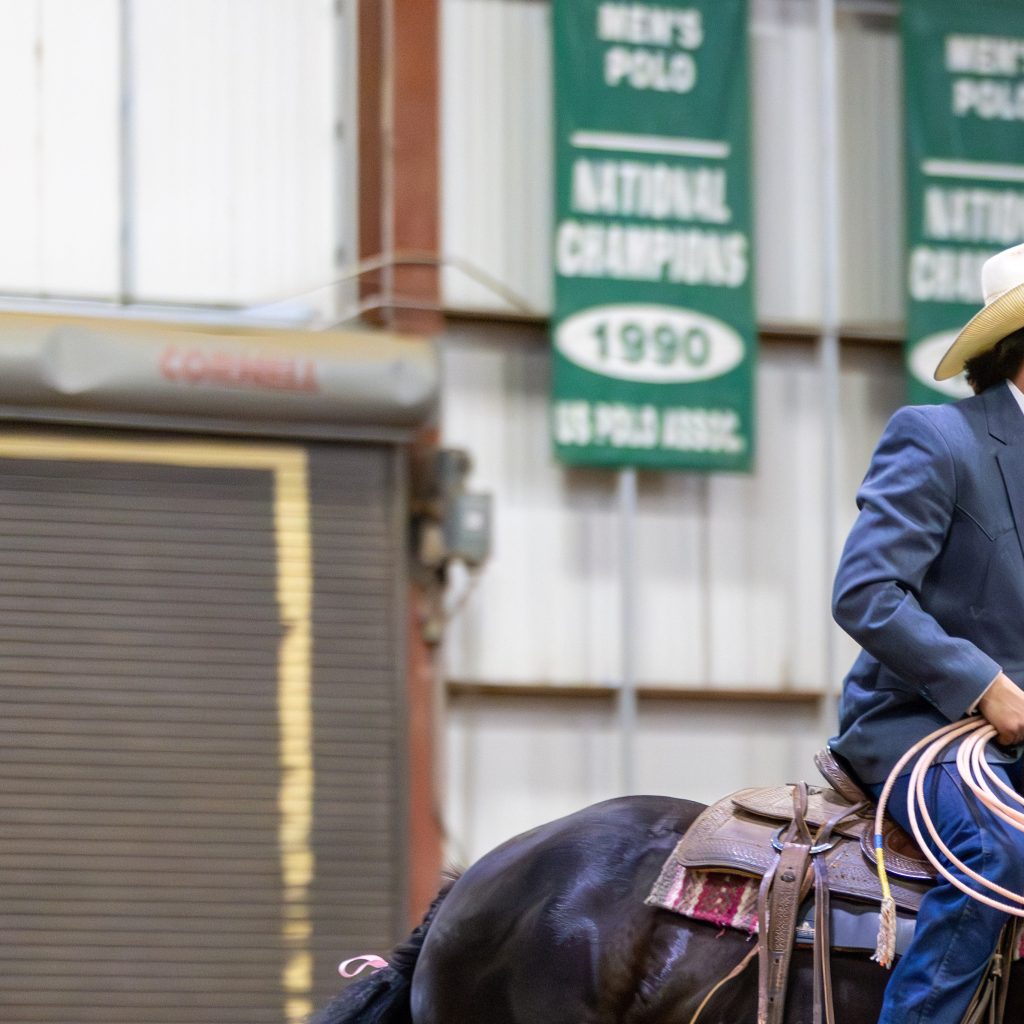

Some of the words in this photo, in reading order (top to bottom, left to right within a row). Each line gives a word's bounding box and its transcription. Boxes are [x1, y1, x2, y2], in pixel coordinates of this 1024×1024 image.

[598, 5, 702, 48] MEN'S
[606, 50, 695, 91] POLO
[573, 160, 729, 221] NATIONAL
[558, 224, 746, 286] CHAMPIONS
[592, 323, 711, 367] 1990
[556, 400, 589, 446] US
[597, 404, 657, 447] POLO
